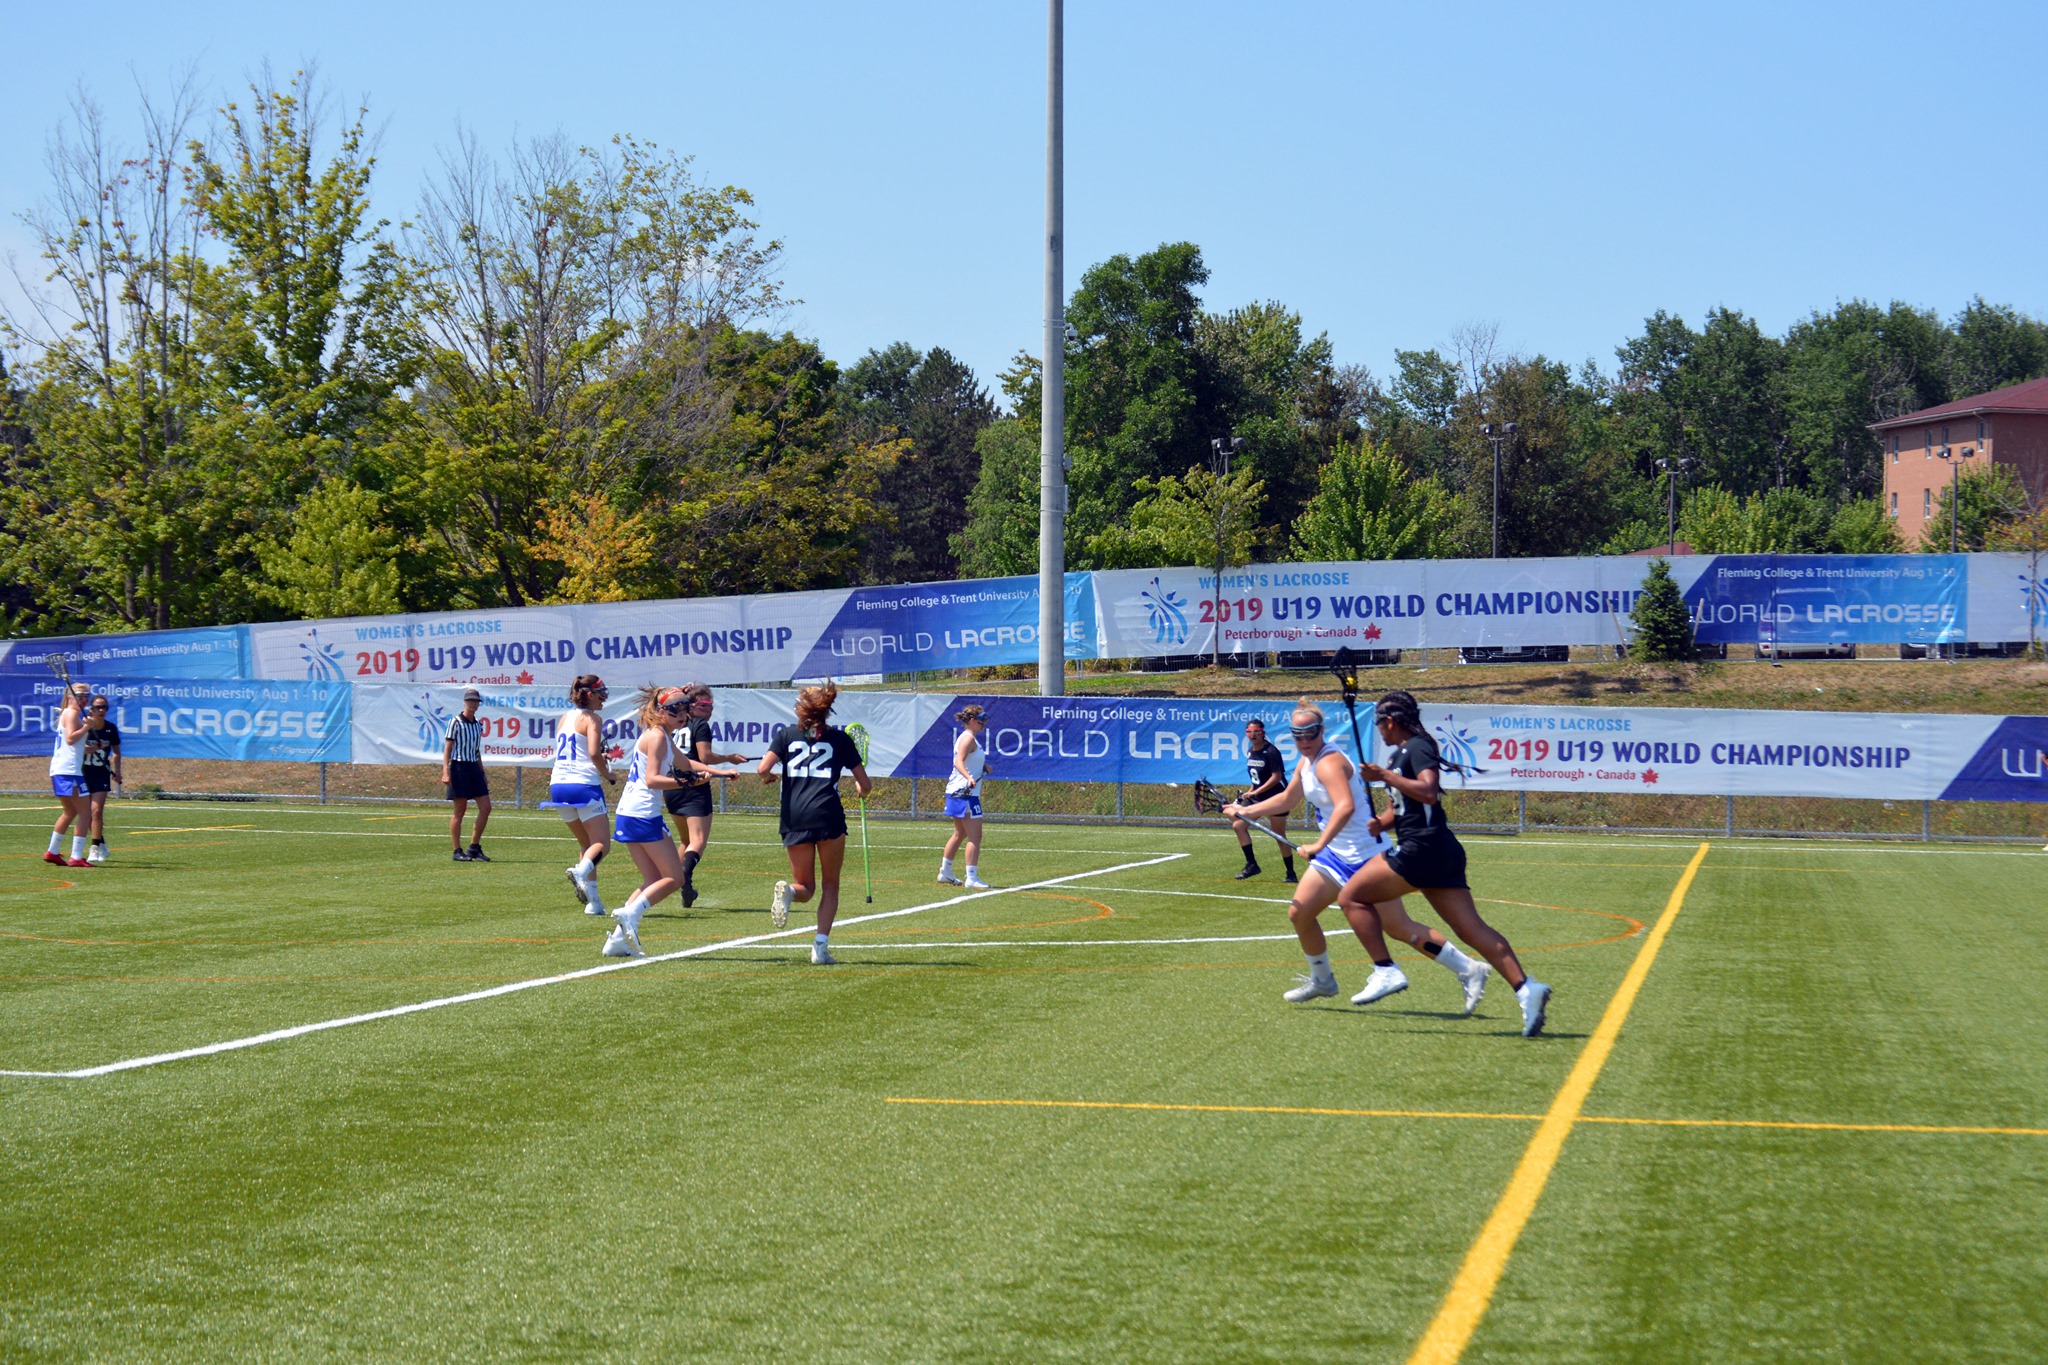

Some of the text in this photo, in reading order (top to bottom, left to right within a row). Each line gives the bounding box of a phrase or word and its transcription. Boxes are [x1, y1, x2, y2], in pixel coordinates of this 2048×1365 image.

[1198, 571, 1350, 589] WOMEN'S LACROSSE
[1717, 567, 1761, 580] Fleming
[1763, 567, 1804, 580] College
[1806, 568, 1815, 577] &
[1816, 567, 1843, 578] Trent
[1846, 567, 1900, 580] University
[1902, 567, 1925, 579] Aug
[856, 599, 898, 611] Fleming
[900, 595, 941, 609] College
[941, 595, 949, 605] &
[950, 593, 977, 605] Trent
[978, 590, 1030, 604] University
[1199, 597, 1263, 623] 2019
[1272, 596, 1322, 620] U19
[1330, 593, 1425, 619] WORLD
[1688, 604, 1956, 624] WORLD LACROSSE
[355, 620, 502, 641] WOMEN'S LACROSSE
[830, 620, 1086, 657] WORLD LACROE
[1225, 626, 1358, 642] Peterborough Canada
[16, 653, 62, 665] Flemig
[63, 650, 100, 663] College
[102, 648, 111, 659] &
[111, 646, 137, 658] Trent
[139, 642, 190, 656] University
[191, 641, 211, 653] Aug
[228, 638, 239, 649] 10
[585, 626, 793, 661] CHAMPIONSHIP
[356, 639, 576, 675] 2019 U19 WORLD
[33, 682, 65, 695] Flem
[91, 684, 139, 699] College
[141, 684, 153, 697] &
[154, 684, 189, 698] Trent
[192, 686, 257, 702] University
[261, 687, 288, 702] Aug
[312, 689, 328, 701] 10
[479, 695, 576, 709] OMEN'S LACRO
[117, 706, 327, 739] LACROSSE
[1042, 706, 1097, 723] Fleming
[1100, 707, 1153, 723] College
[1156, 708, 1166, 721] &
[1168, 708, 1205, 722] Trent
[1210, 709, 1279, 725] University
[1335, 711, 1351, 723] 10
[1489, 716, 1632, 732] WOMEN'S LACROSSE
[481, 717, 556, 739] 019 U1
[484, 744, 554, 758] Peterborough
[557, 733, 577, 761] 21
[1129, 730, 1351, 760] LACRSE
[1488, 738, 1911, 769] 2019 U19 WORLD CHAMPIONSHIP
[787, 740, 833, 779] 22
[1511, 767, 1636, 782] Peterborough Canada
